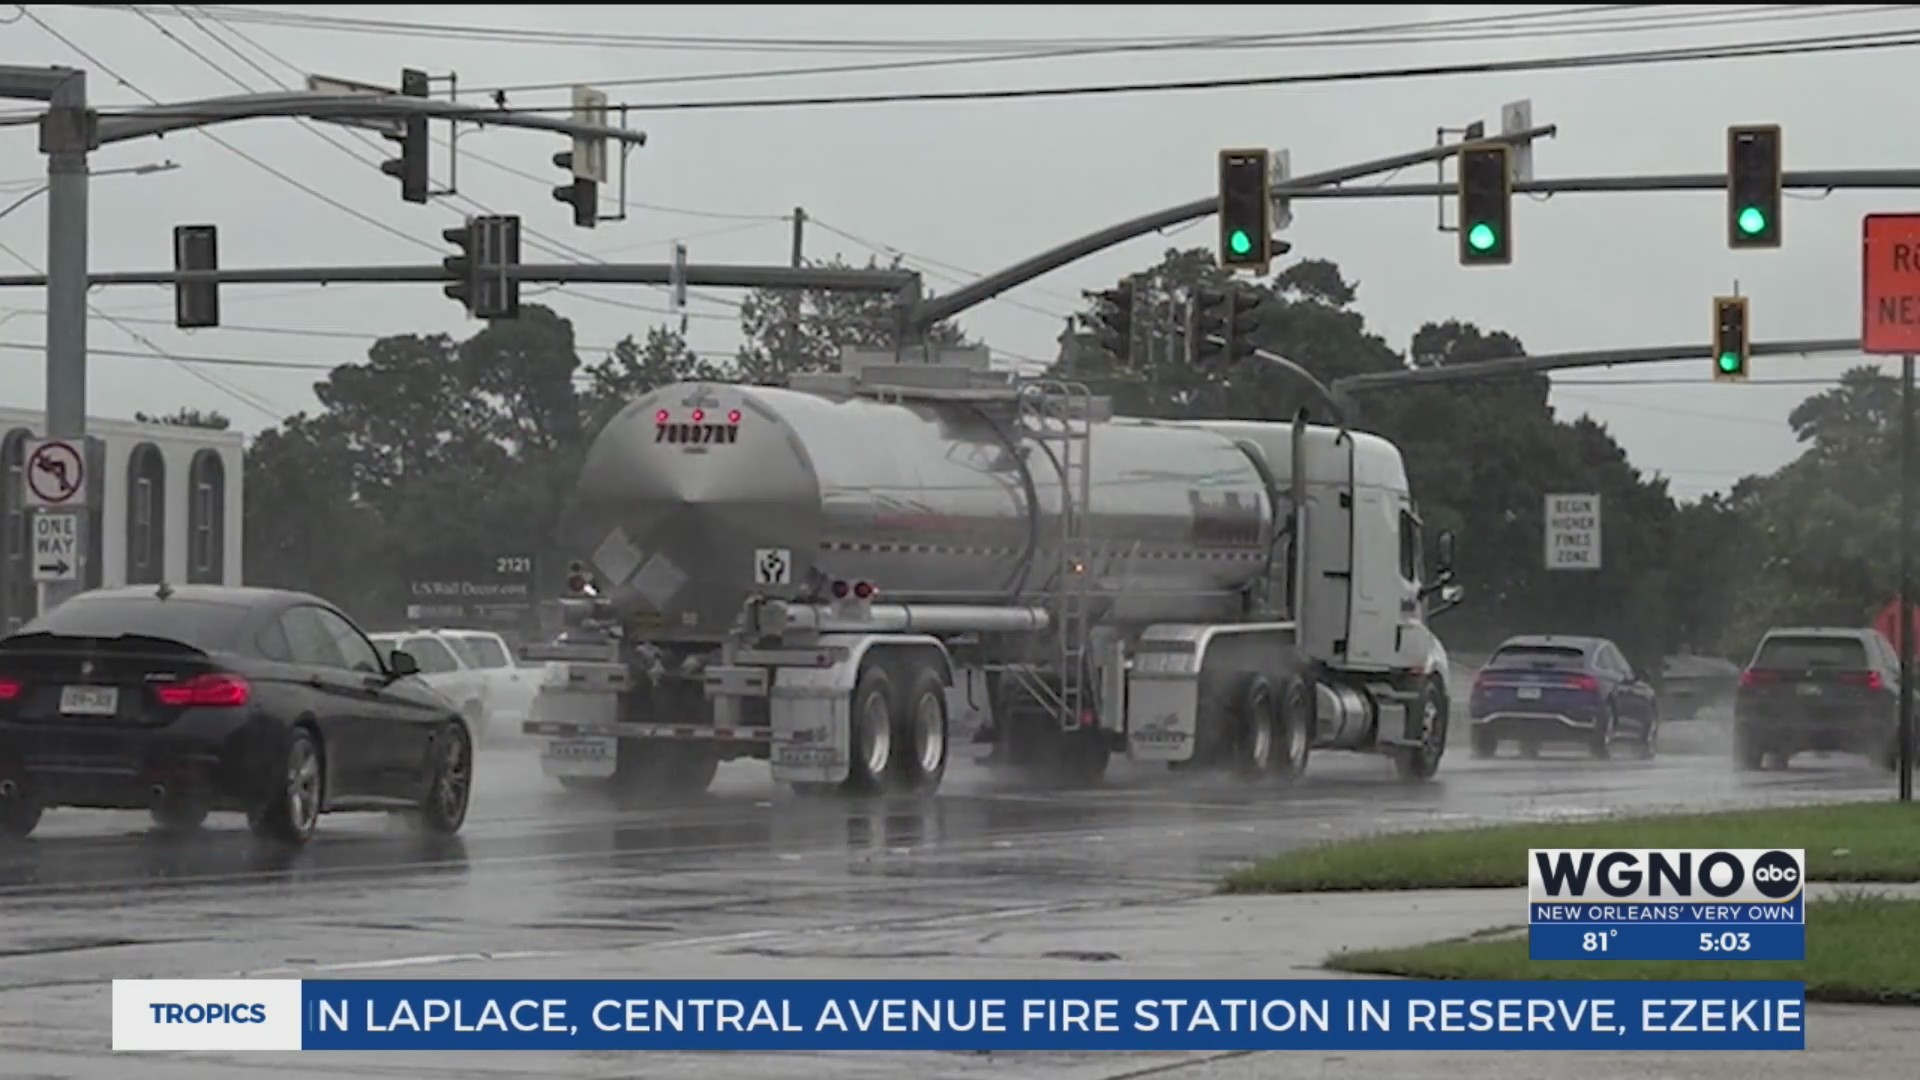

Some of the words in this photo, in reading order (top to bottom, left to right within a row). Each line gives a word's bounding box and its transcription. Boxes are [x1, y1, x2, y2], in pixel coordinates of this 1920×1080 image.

[1878, 296, 1920, 325] NE
[1555, 501, 1592, 514] BEGIN
[38, 518, 72, 534] ONE
[1551, 517, 1594, 530] HIGHER
[38, 538, 73, 553] WAY
[1555, 533, 1590, 546] FINES
[1557, 549, 1588, 562] ZONE
[497, 557, 531, 573] 2121
